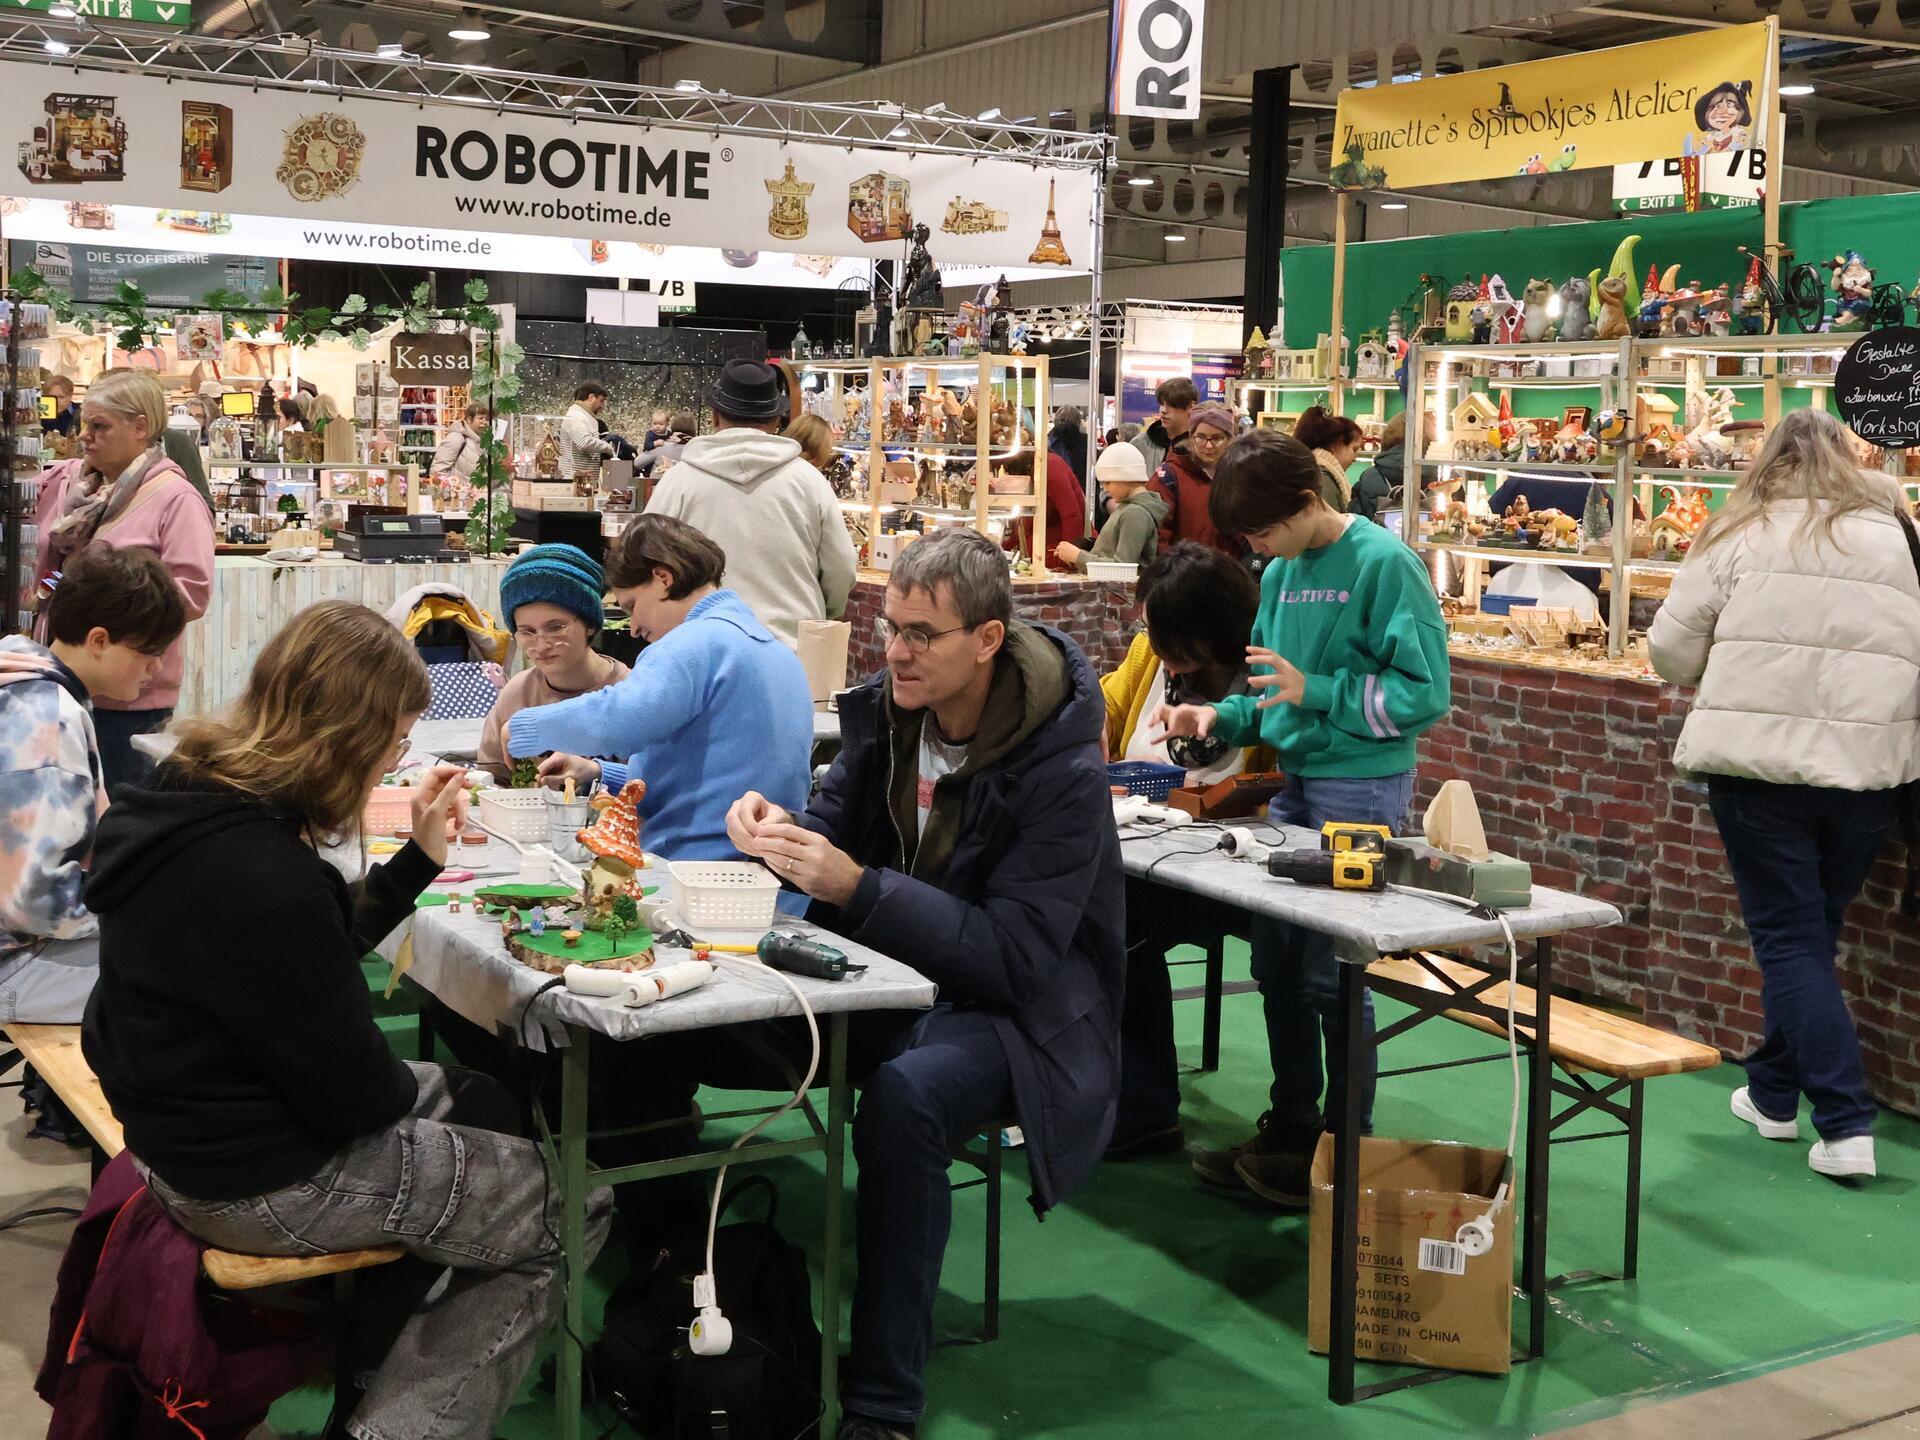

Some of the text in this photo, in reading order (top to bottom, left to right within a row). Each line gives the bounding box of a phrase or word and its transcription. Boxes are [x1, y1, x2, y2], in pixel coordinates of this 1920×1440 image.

[60, 0, 114, 16] XIT
[1136, 0, 1192, 110] RO
[1342, 78, 1697, 154] Zwanette's Sprookjes Atelier
[415, 125, 710, 200] ROBOTIME
[455, 195, 671, 228] www.robotime.de
[1640, 196, 1666, 209] EXIT
[1728, 197, 1750, 207] EXIT
[303, 229, 492, 256] www.robotime.de
[86, 251, 111, 263] DIE
[395, 346, 470, 369] Kassa
[1856, 341, 1917, 364] Gestalte
[1374, 1272, 1410, 1287] SETS
[1398, 1327, 1411, 1337] IN
[1419, 1328, 1461, 1344] CHINA
